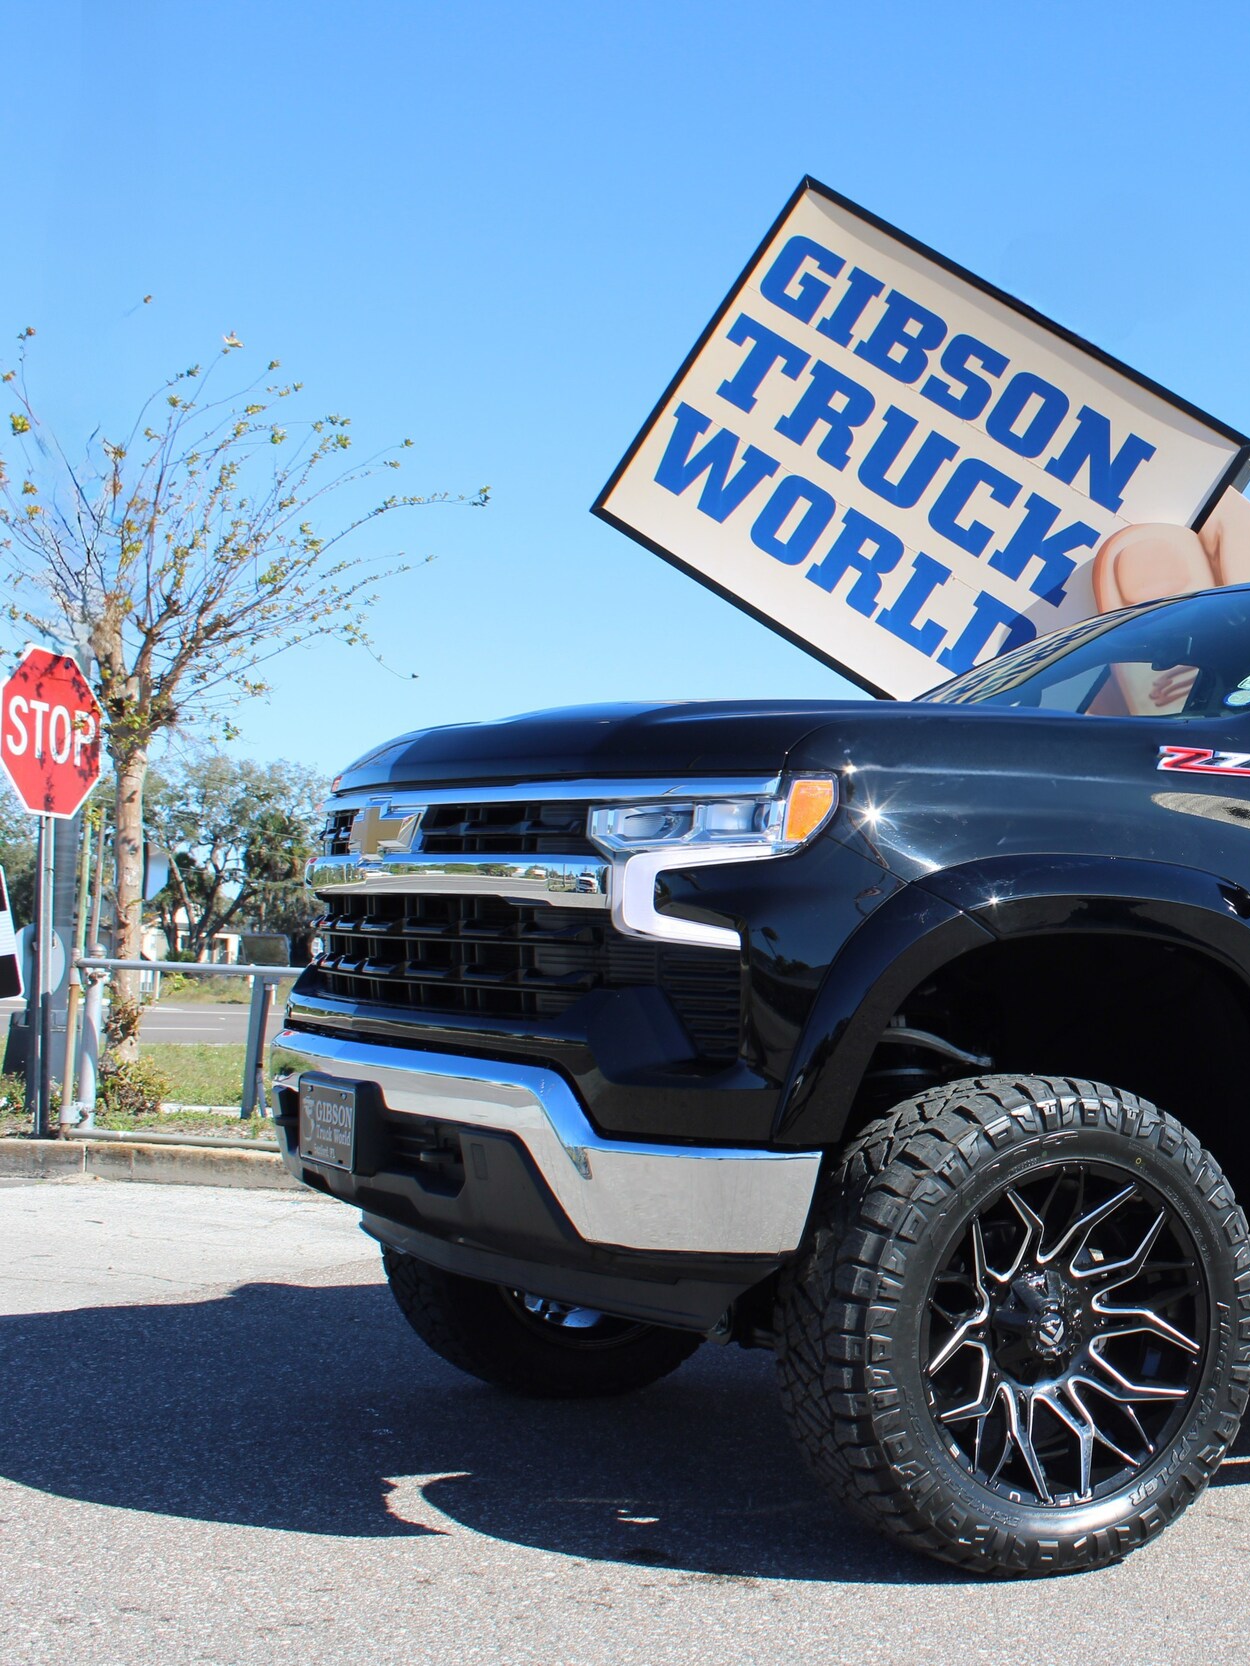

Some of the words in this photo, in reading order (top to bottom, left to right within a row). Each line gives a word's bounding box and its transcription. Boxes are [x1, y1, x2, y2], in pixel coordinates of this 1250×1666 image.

[716, 312, 1101, 608] TRUCK
[759, 236, 1156, 513] GIBSON
[653, 402, 1037, 676] WORLD
[6, 695, 96, 767] STOP
[316, 1100, 353, 1129] GIBSON
[333, 1128, 352, 1146] World
